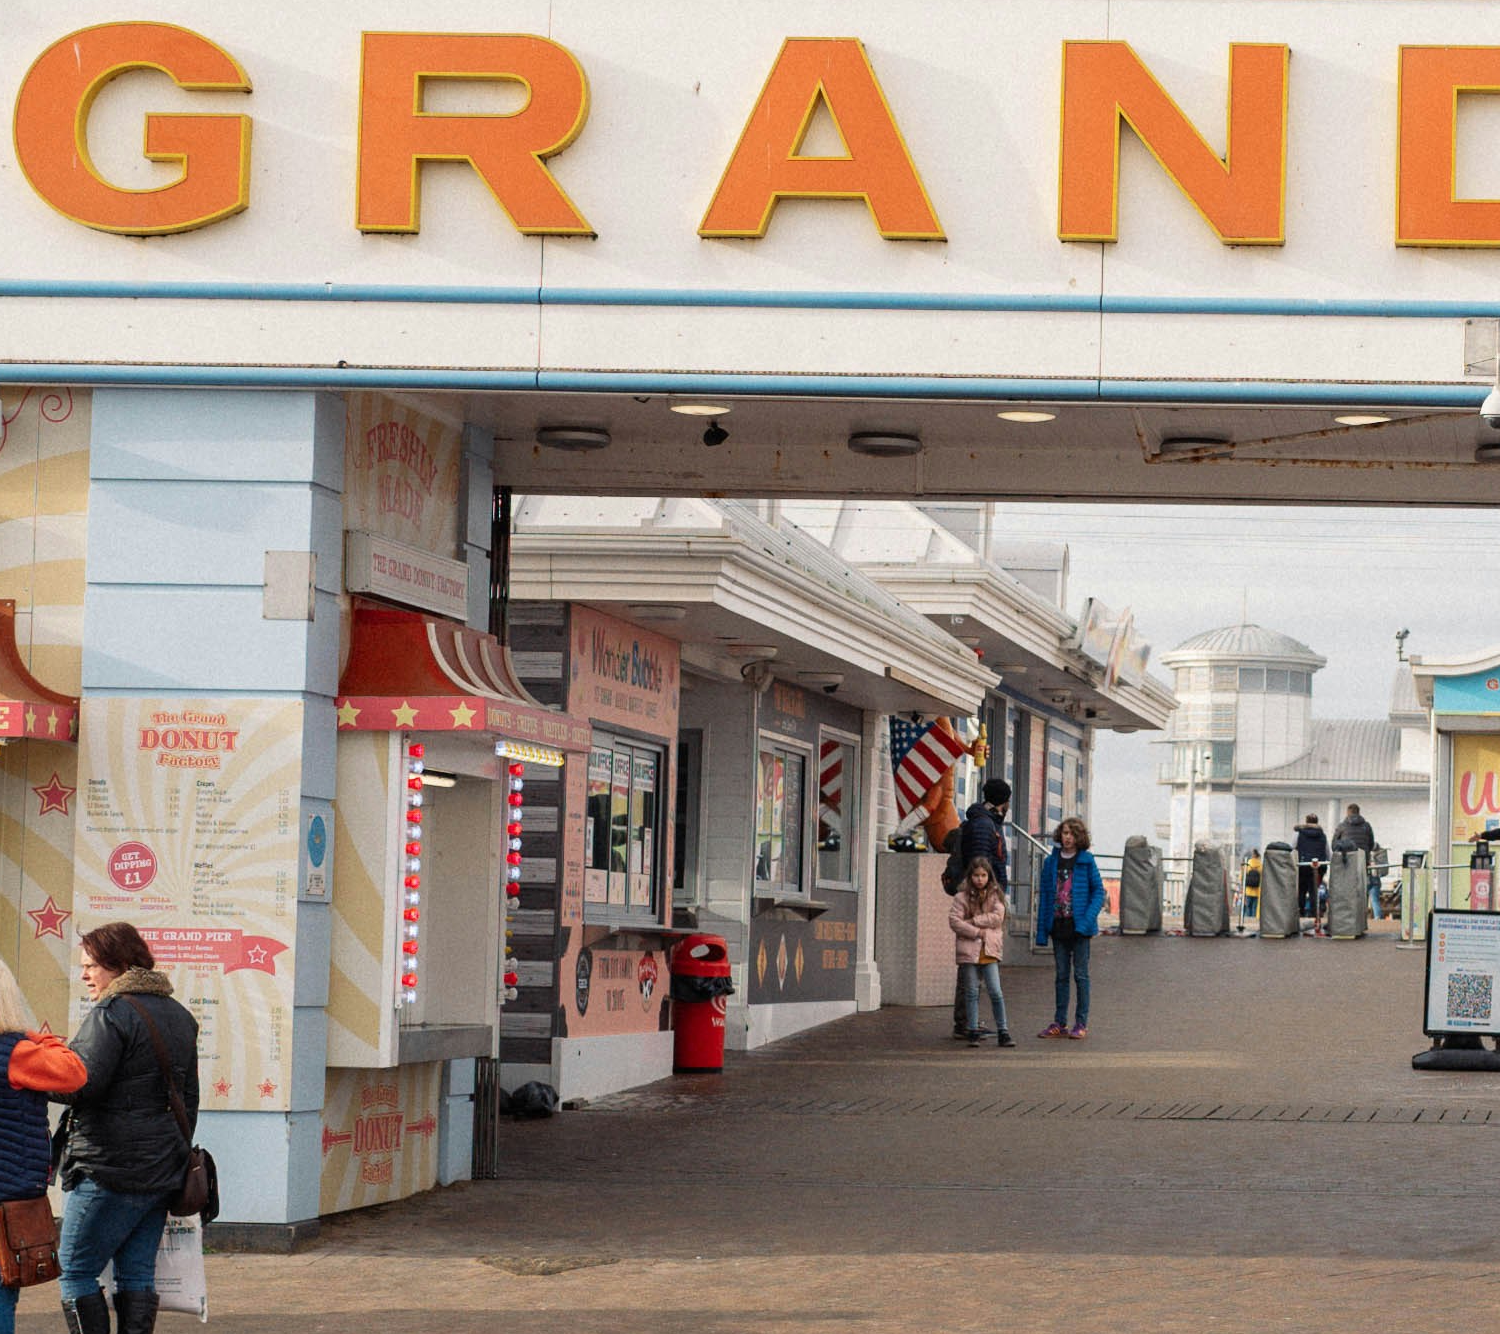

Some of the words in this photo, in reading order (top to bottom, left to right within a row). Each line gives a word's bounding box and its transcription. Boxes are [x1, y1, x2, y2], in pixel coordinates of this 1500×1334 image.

[366, 421, 438, 496] FRESHLY
[376, 474, 425, 530] MADE
[373, 553, 387, 574] THE
[388, 556, 412, 582] GRAND
[414, 566, 435, 588] DONUT
[437, 575, 466, 599] FACTORY
[592, 626, 630, 683] Wonder
[631, 640, 663, 694] Bubble
[151, 712, 179, 725] The
[181, 710, 227, 726] Grand
[488, 708, 512, 728] DONUTS
[542, 720, 568, 742] WAFFLES
[139, 728, 239, 751] DONUT
[157, 753, 221, 769] Factory
[114, 859, 152, 871] DIPPING
[121, 851, 141, 861] GET
[124, 872, 142, 885] £1
[163, 931, 202, 941] GRAND
[205, 932, 233, 942] PIER
[354, 1113, 404, 1153] DONUT
